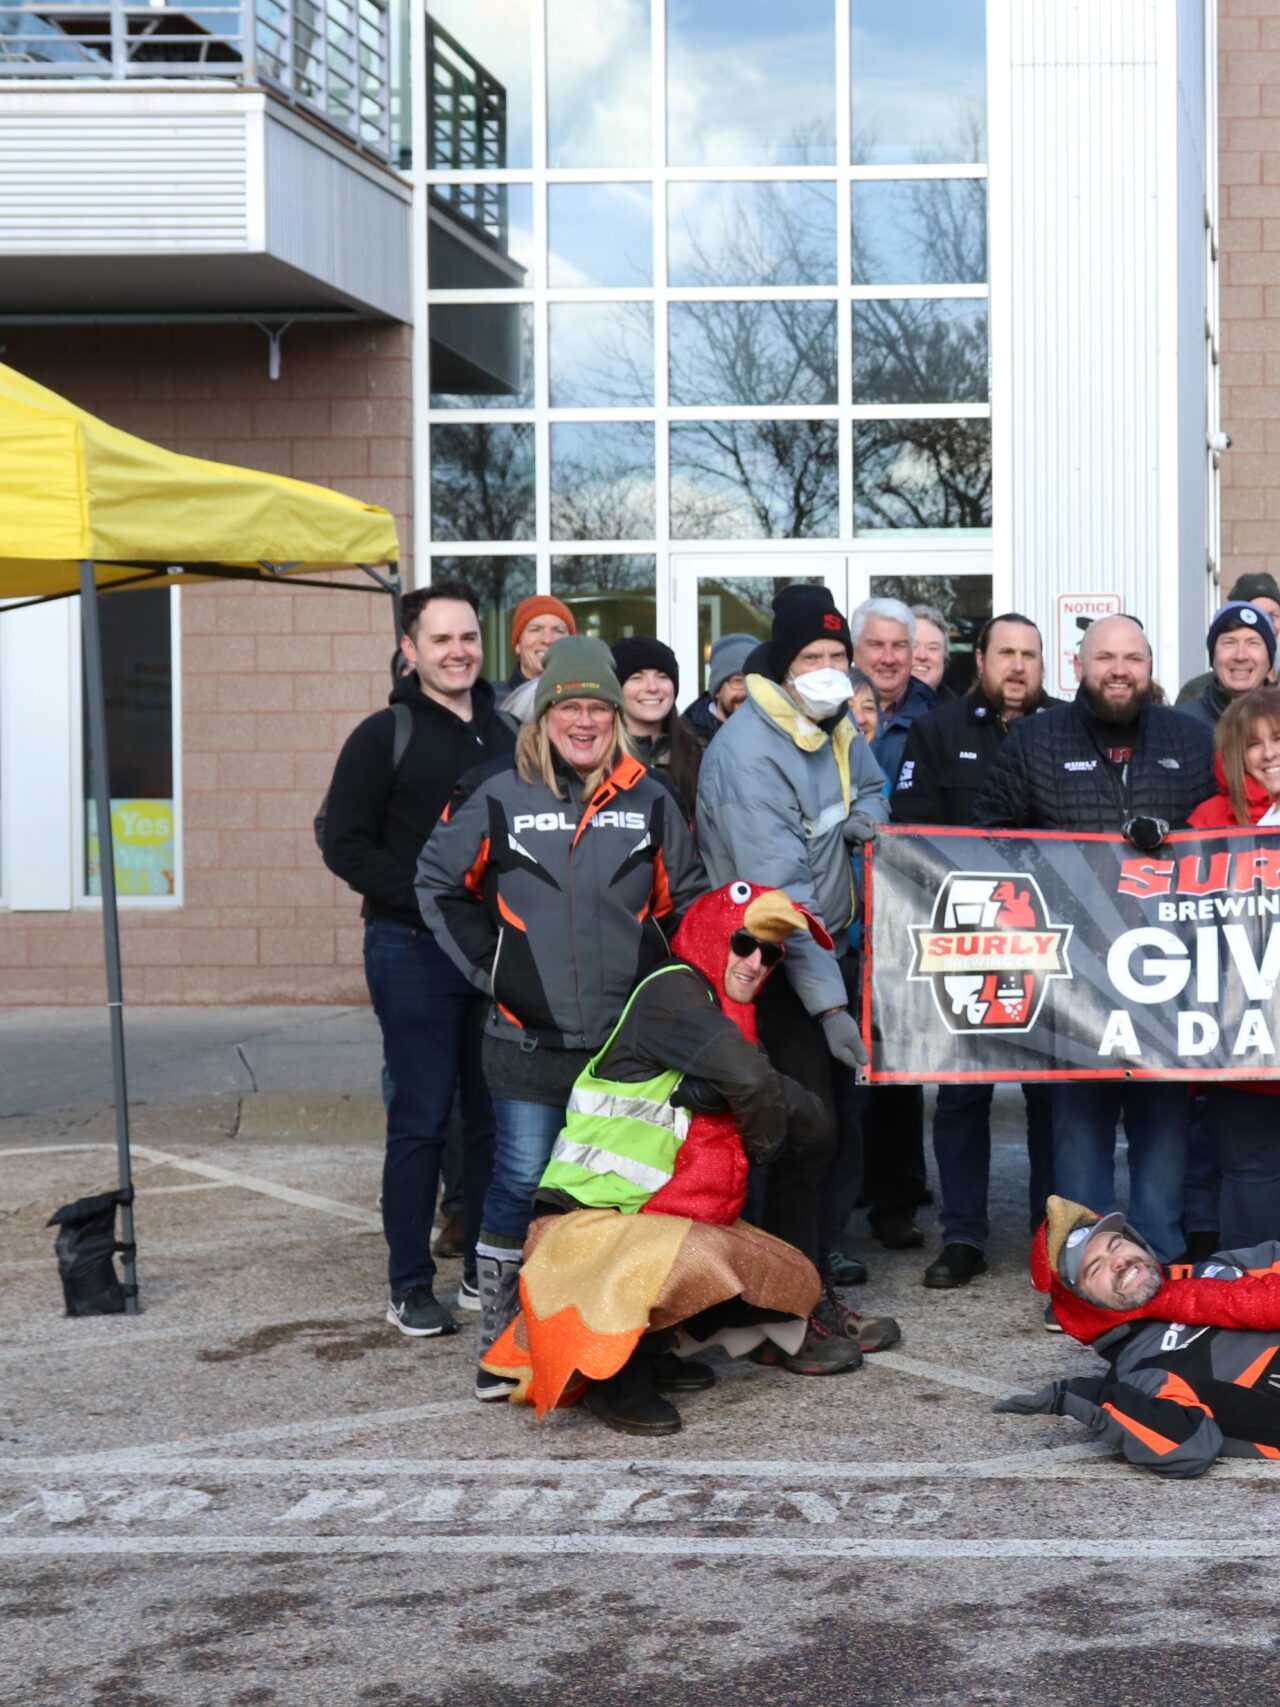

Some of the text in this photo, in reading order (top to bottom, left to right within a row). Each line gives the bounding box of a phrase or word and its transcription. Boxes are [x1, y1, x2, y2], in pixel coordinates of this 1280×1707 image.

[1063, 602, 1113, 613] NOTICE
[119, 811, 170, 837] Yes
[928, 935, 1056, 957] SURLY
[1098, 1010, 1142, 1056] A
